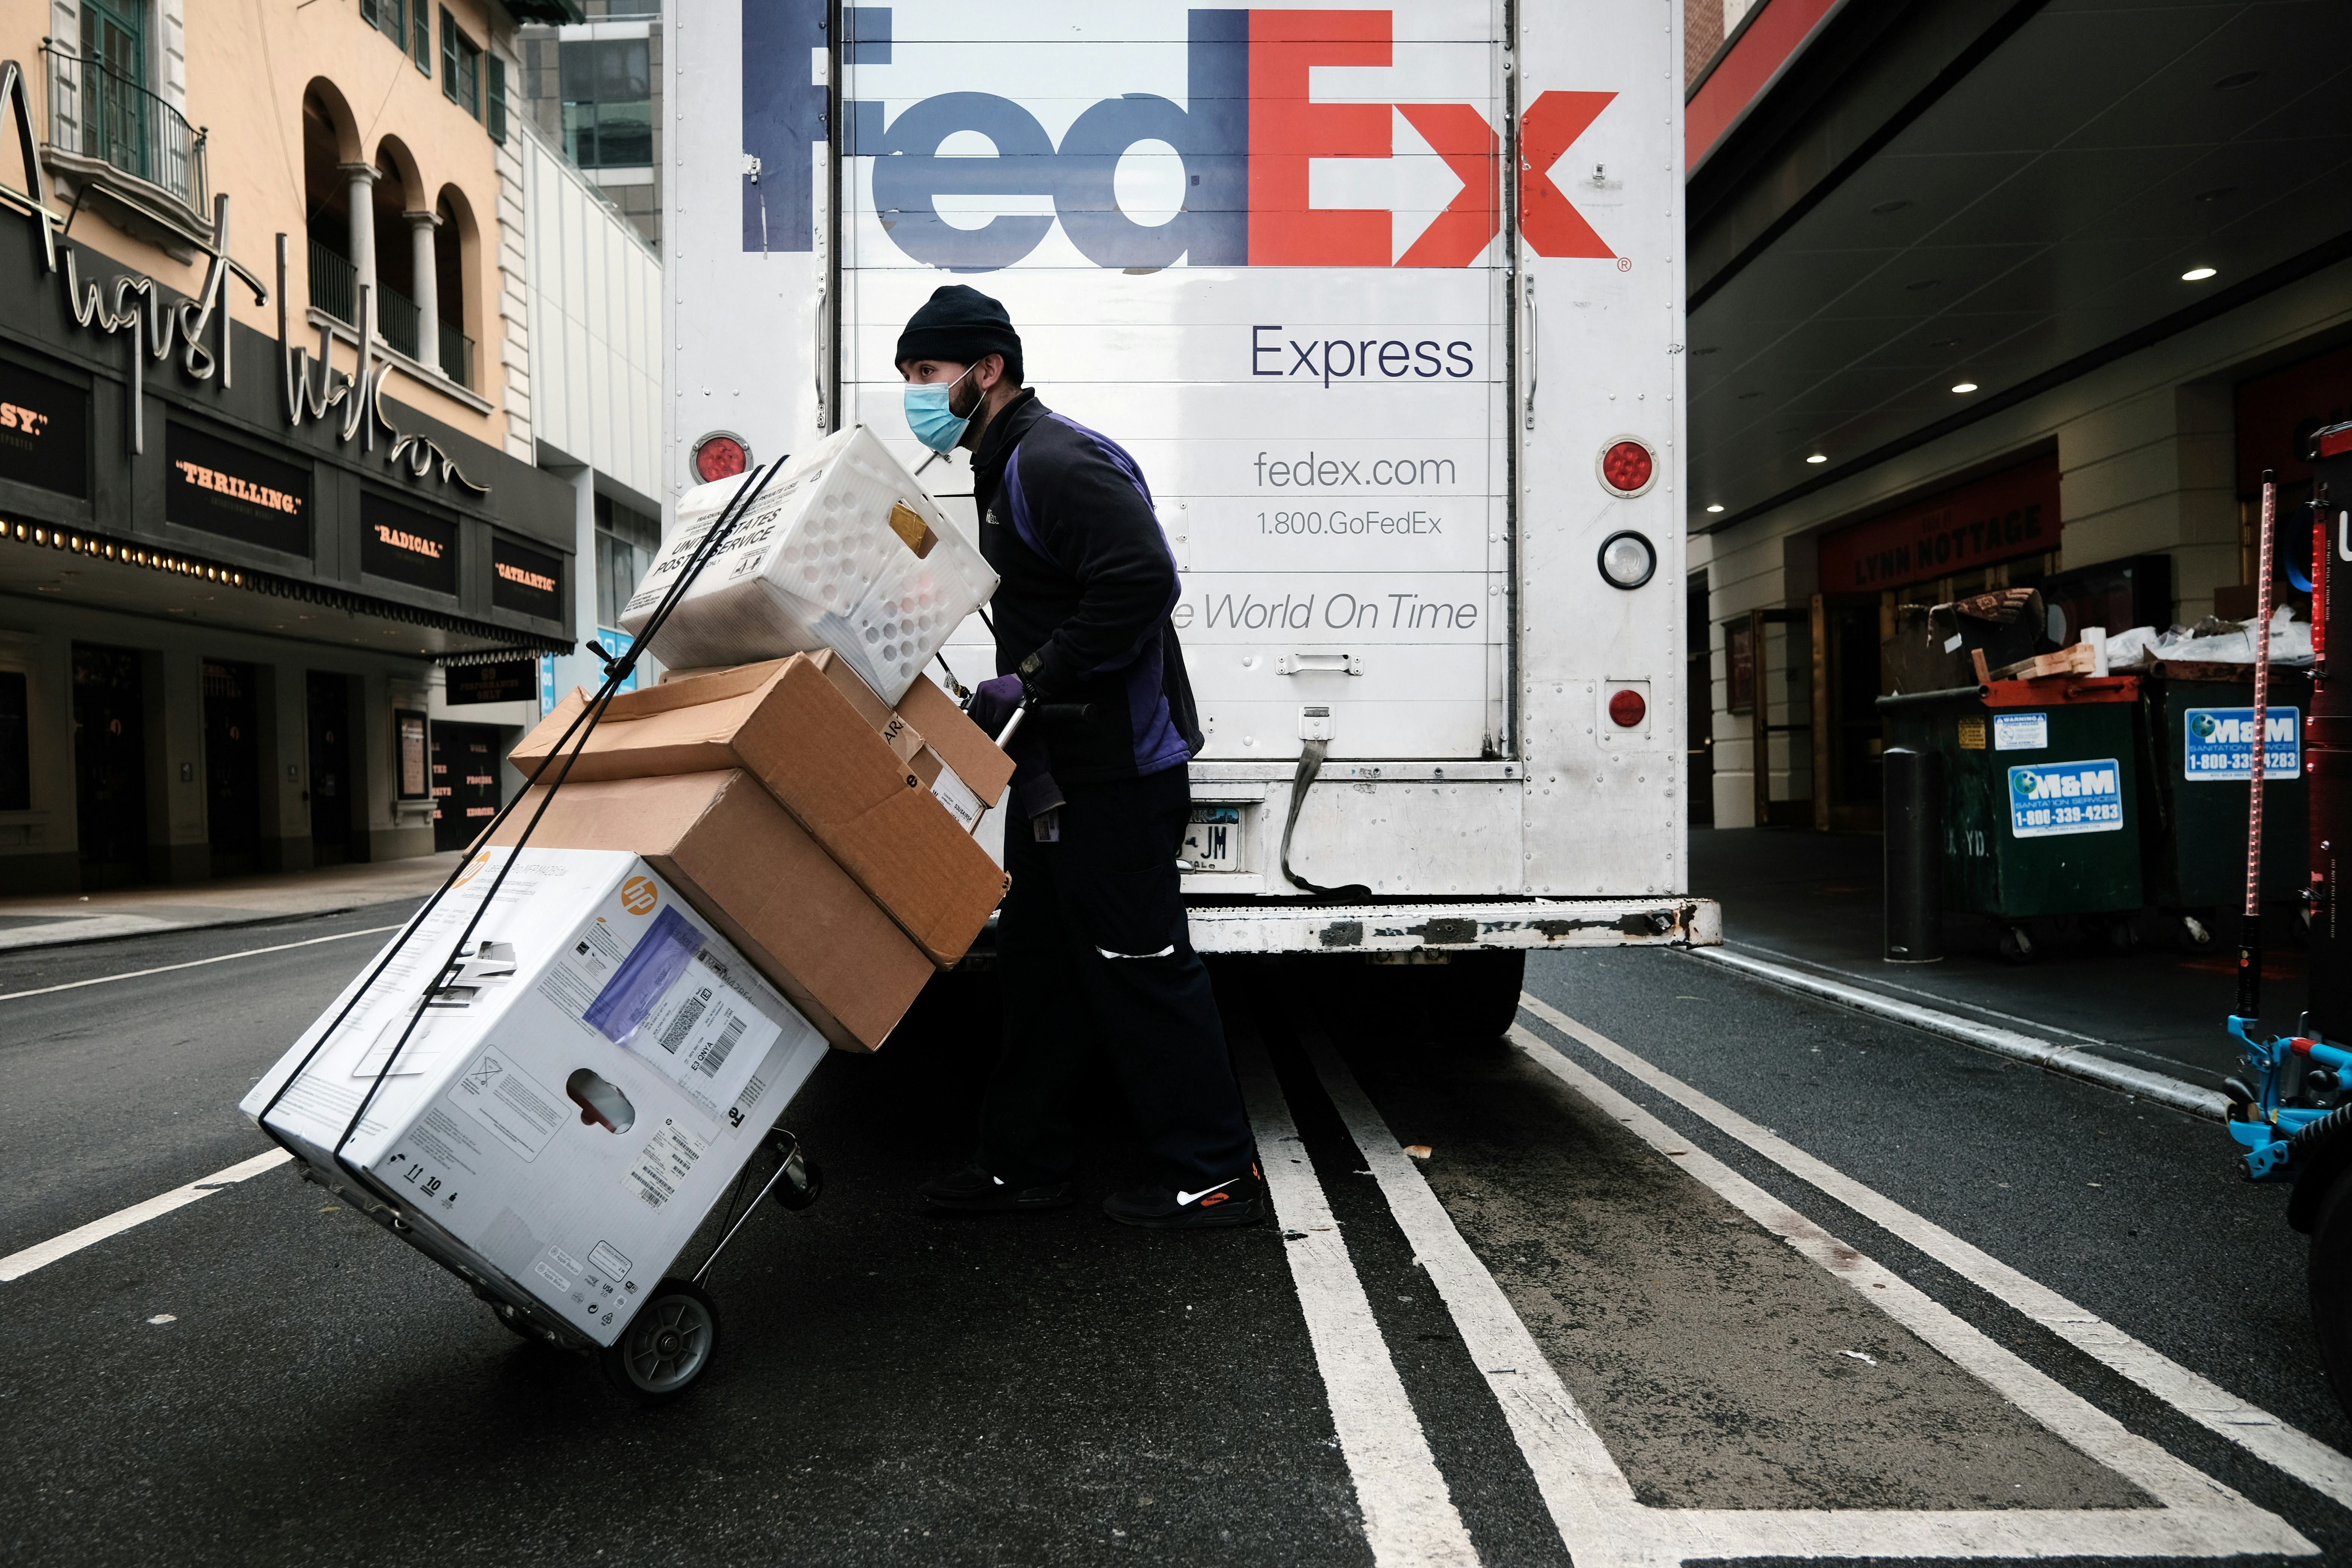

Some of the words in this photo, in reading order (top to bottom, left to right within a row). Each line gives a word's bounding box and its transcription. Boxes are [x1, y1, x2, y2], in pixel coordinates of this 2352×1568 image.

[742, 0, 1619, 274] FedEx
[1252, 326, 1473, 388] Express
[1254, 452, 1455, 486] fedex.com
[783, 481, 798, 493] USE
[1257, 511, 1442, 535] 1.800.GoFedEx
[672, 530, 726, 555] UNITD
[1855, 544, 1910, 586] LYNN
[1918, 503, 2042, 568] NOTTAGE
[653, 549, 708, 576] POSTL
[1205, 594, 1314, 628] World
[1325, 593, 1377, 628] On
[1387, 594, 1477, 628] Time
[2190, 744, 2246, 752] SANITATION
[2028, 770, 2115, 800] M&M
[2015, 799, 2069, 809] SANITATION
[2072, 795, 2117, 805] SERVICES
[1190, 809, 1208, 823] RK
[2016, 804, 2118, 827] 1-800-339-4283
[514, 864, 524, 873] Pro
[622, 876, 658, 916] hp
[690, 1060, 700, 1070] E3
[697, 1041, 714, 1061] QNYA
[427, 1176, 441, 1191] 10
[555, 1254, 567, 1265] Apple
[602, 1283, 614, 1294] USB
